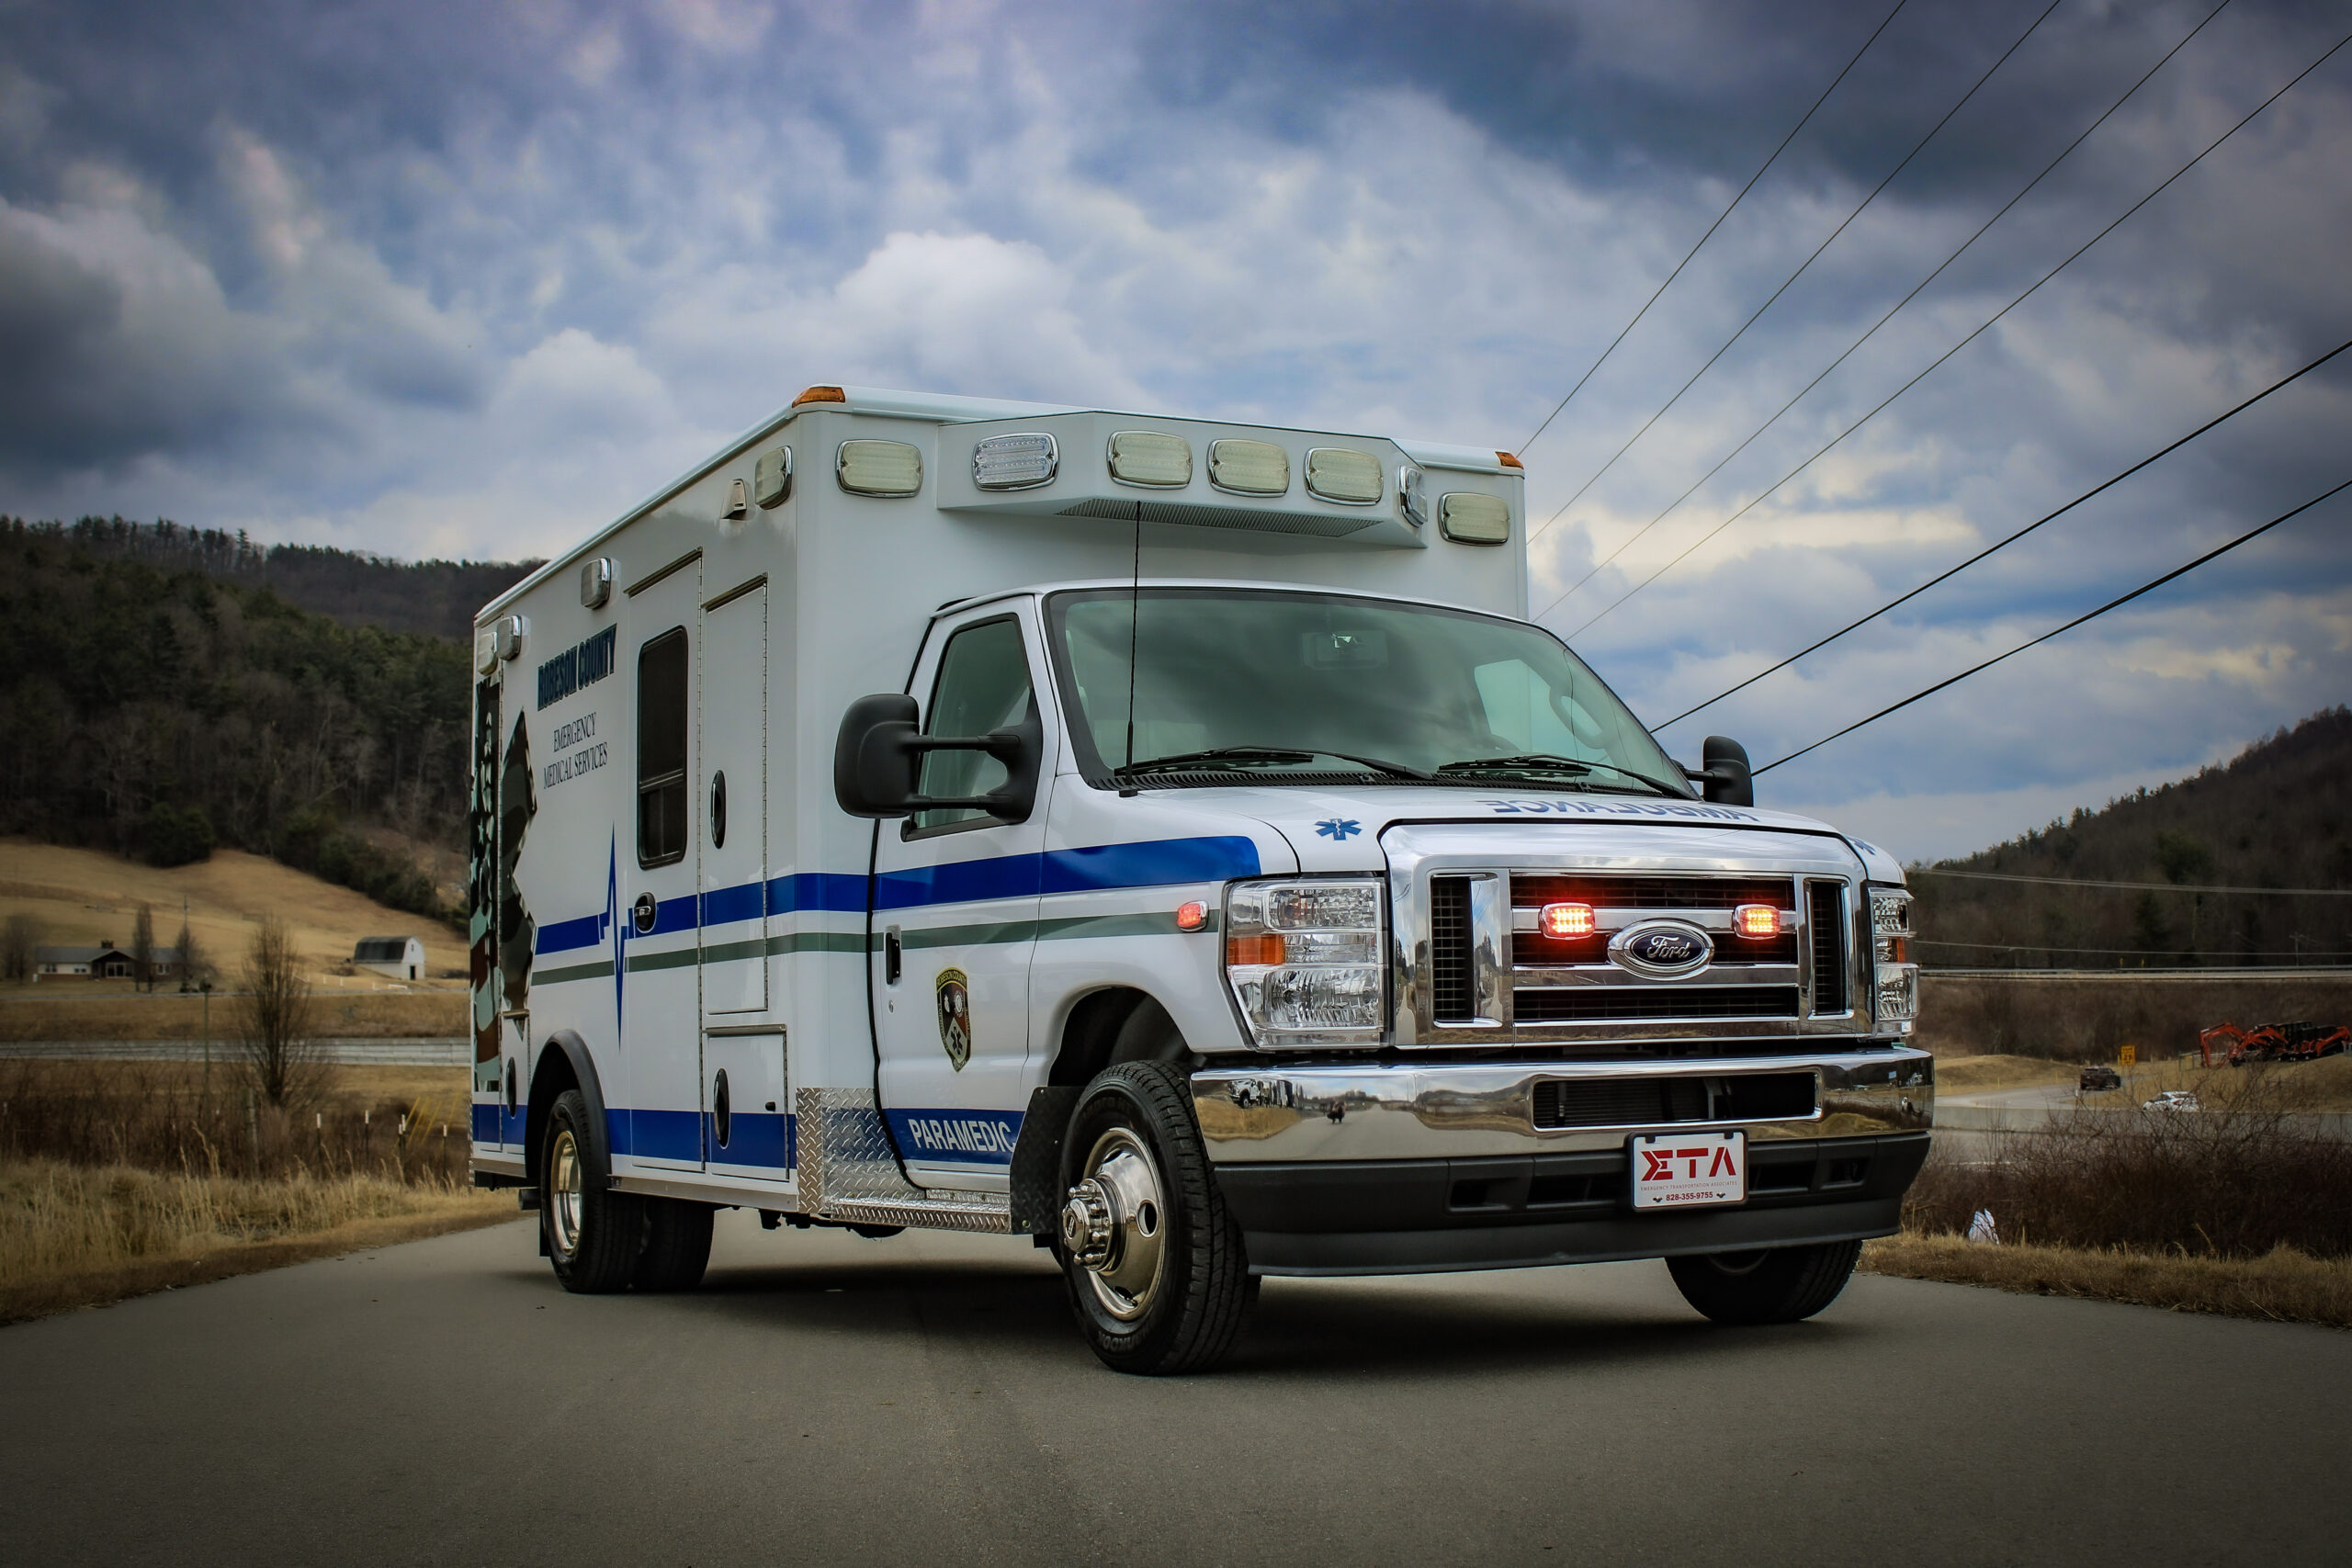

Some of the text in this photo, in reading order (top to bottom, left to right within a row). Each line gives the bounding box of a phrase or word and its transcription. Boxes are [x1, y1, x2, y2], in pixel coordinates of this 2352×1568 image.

[537, 623, 617, 712] ROBESON COUNTY
[553, 712, 596, 752] EMERGENCY
[544, 742, 608, 789] MEDICAL SERVICES
[1646, 935, 1690, 958] Ford
[908, 1119, 1016, 1153] PARAMEDIC
[1666, 1191, 1713, 1201] 828-355-9755
